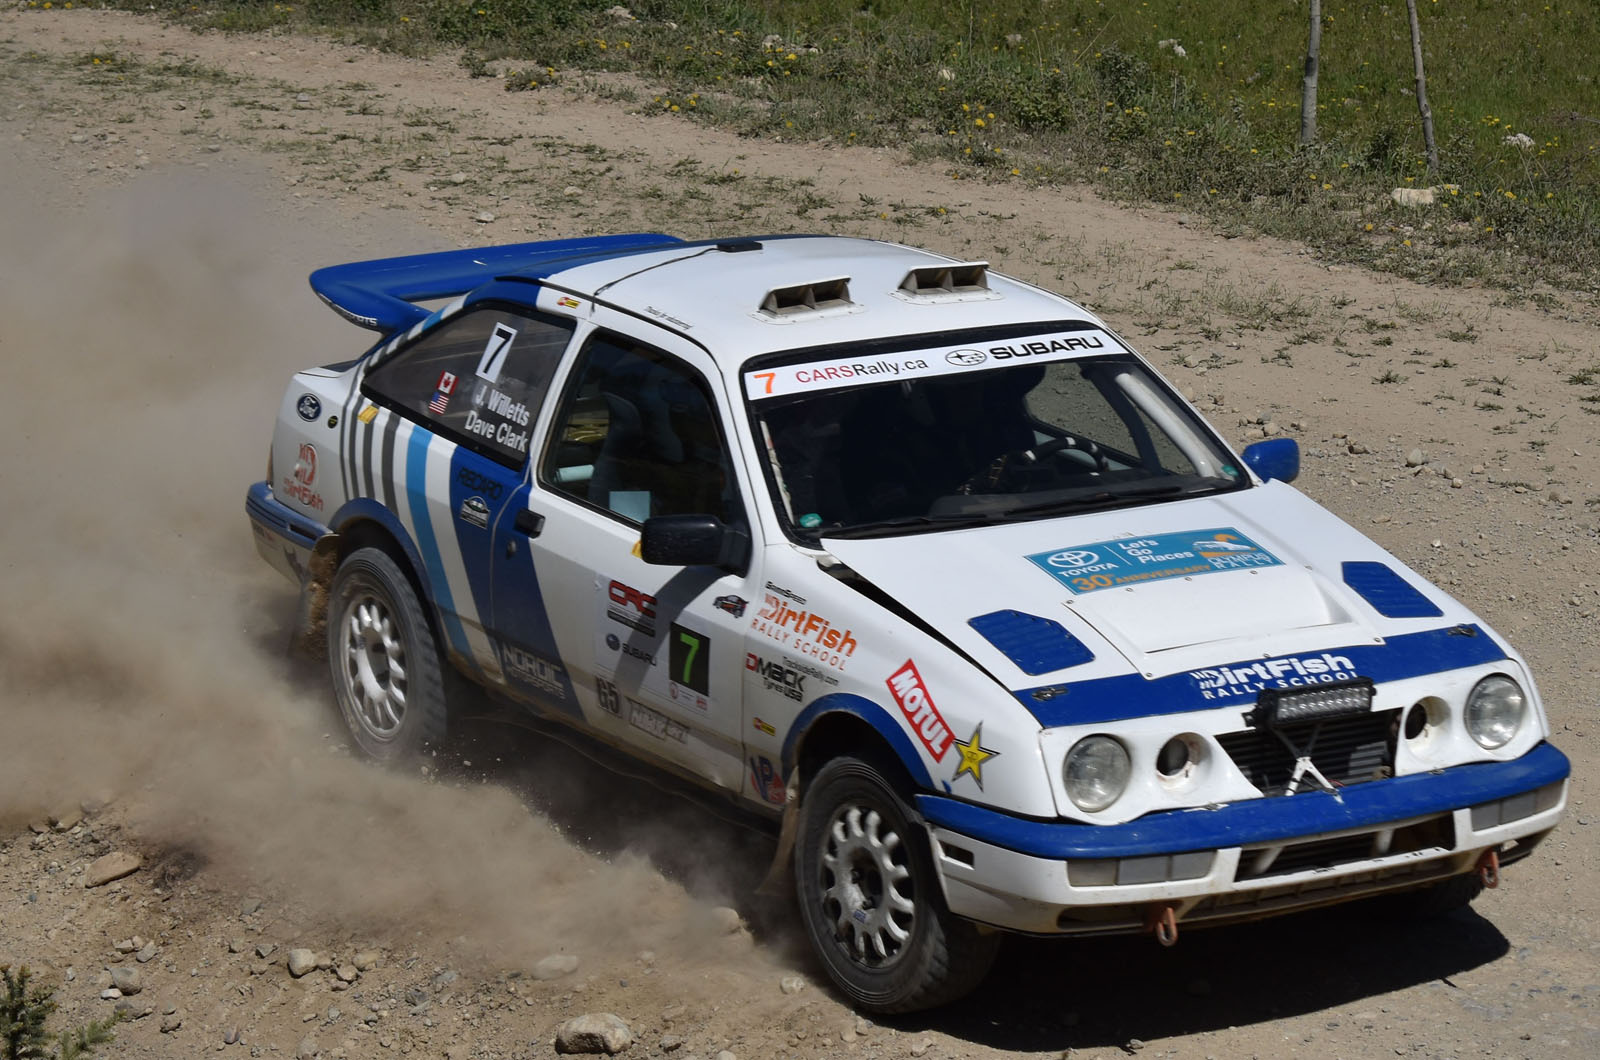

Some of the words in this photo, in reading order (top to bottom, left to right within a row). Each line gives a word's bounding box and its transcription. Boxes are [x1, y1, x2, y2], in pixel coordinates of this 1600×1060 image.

[483, 327, 514, 375] 7
[989, 336, 1105, 360] SUBARU
[753, 372, 777, 394] 7
[795, 359, 929, 384] CARSRally.ca
[475, 385, 488, 407] J.
[487, 389, 531, 427] Willetts
[464, 410, 496, 439] Dave
[496, 423, 529, 452] Clark
[1058, 562, 1119, 578] TOYOTA
[1126, 548, 1153, 557] Go
[1137, 551, 1195, 564] Places
[609, 580, 657, 619] CRC
[750, 618, 790, 643] RALLY
[794, 638, 847, 671] SCHOOL
[756, 593, 858, 658] DirtFish
[680, 632, 700, 685] 7
[1190, 653, 1356, 691] DirtFish
[1201, 682, 1266, 700] RALLY
[890, 668, 950, 755] MOTUL
